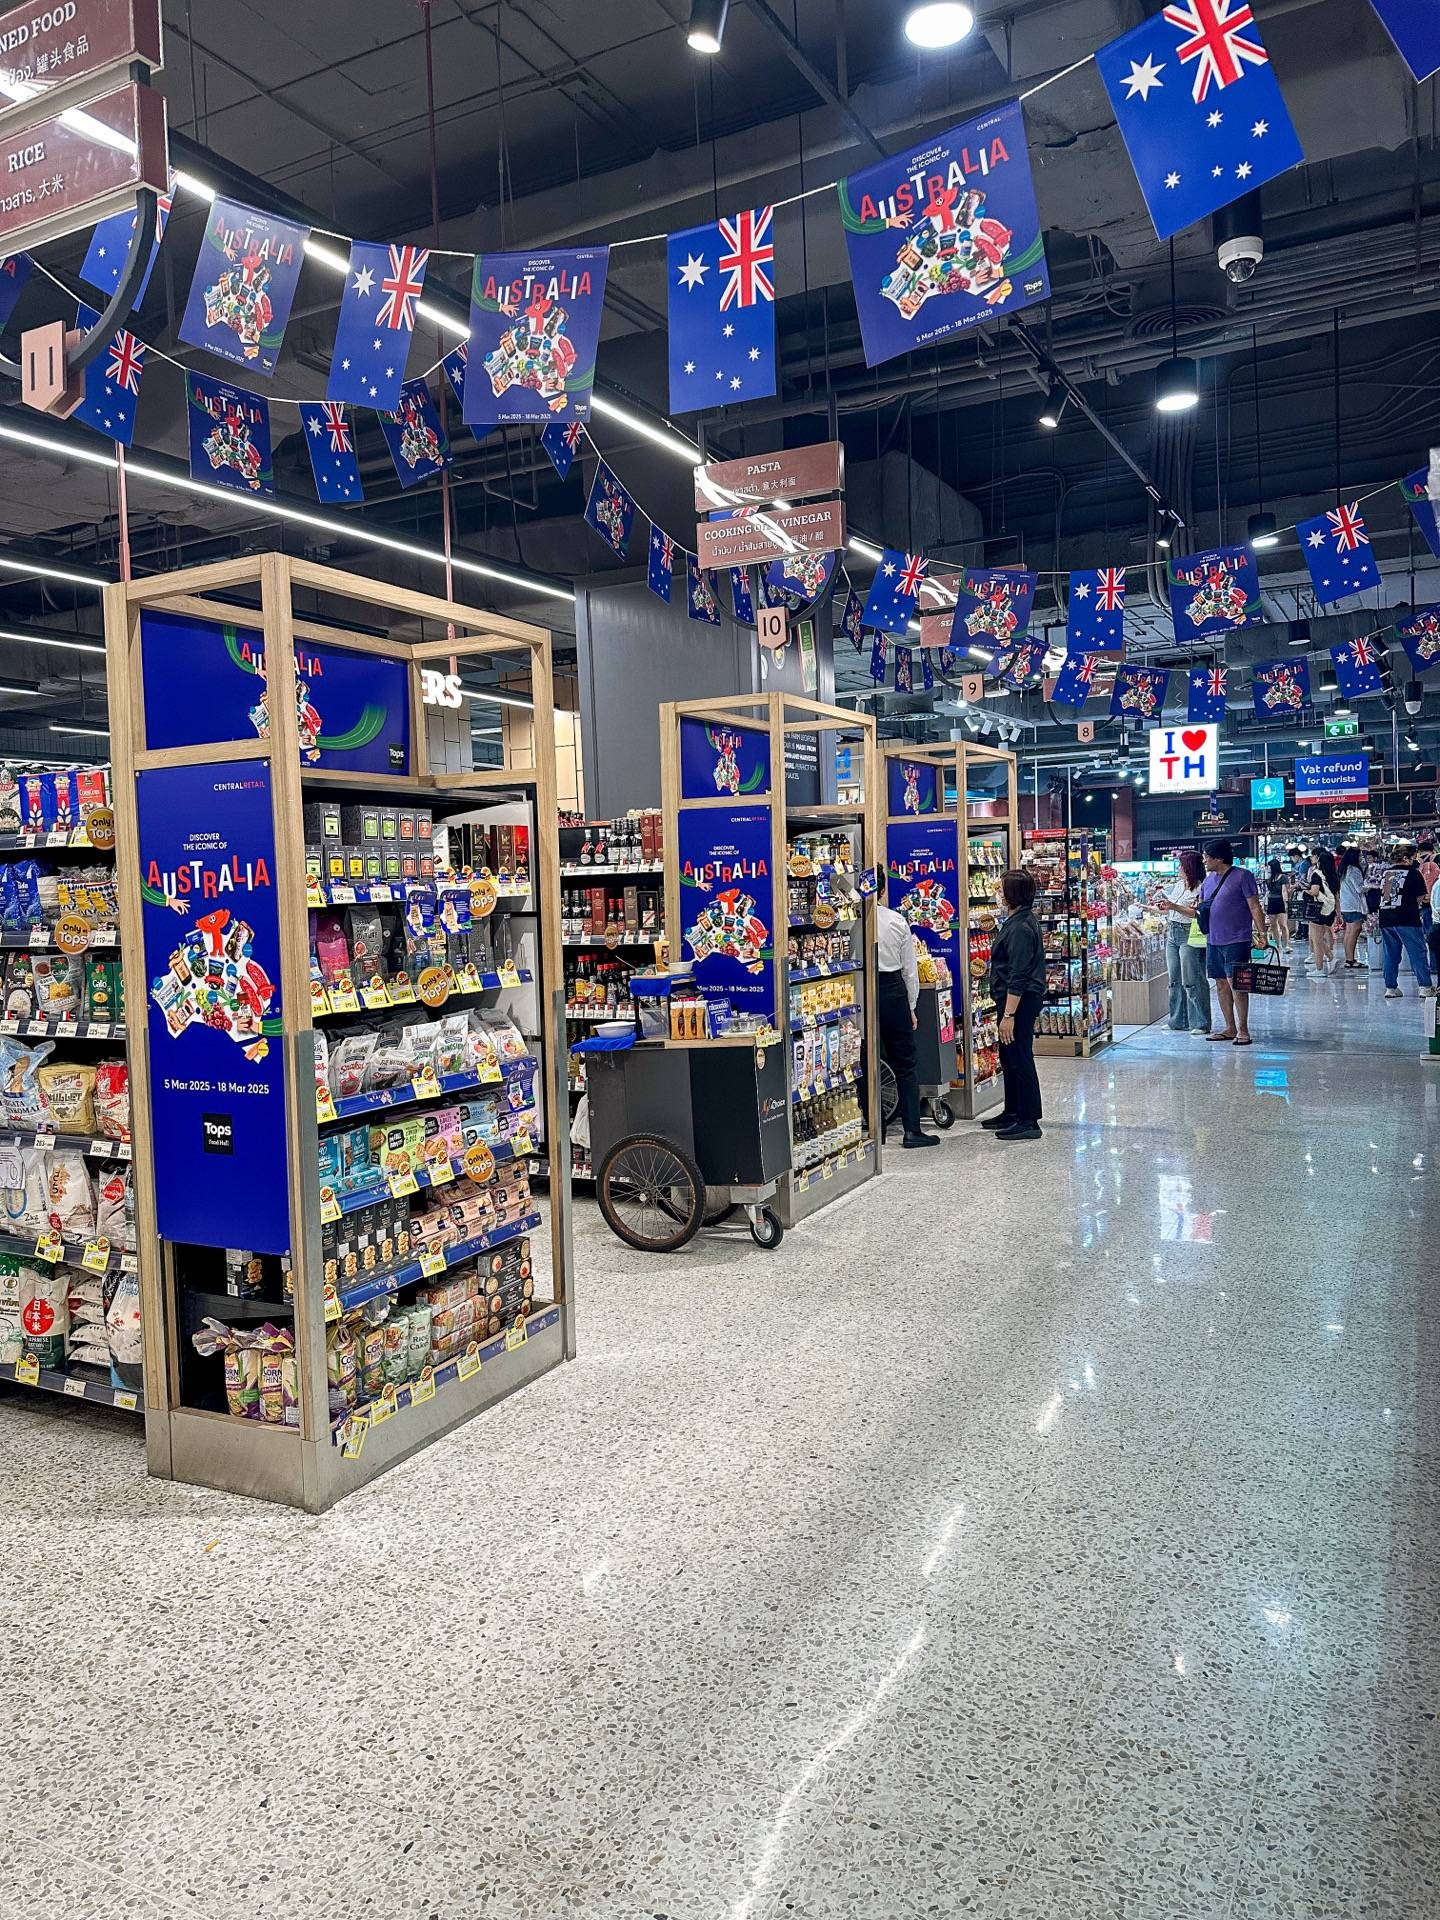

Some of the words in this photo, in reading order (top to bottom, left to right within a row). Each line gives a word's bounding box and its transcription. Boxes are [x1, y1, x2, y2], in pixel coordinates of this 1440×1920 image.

[31, 1, 76, 38] FOOD
[36, 34, 89, 75] 罐头食品
[976, 116, 1001, 132] CENTRAL
[8, 142, 45, 173] RICE
[906, 162, 918, 174] THE
[918, 153, 941, 169] ICONIC
[941, 150, 950, 159] OF
[911, 146, 942, 164] DISCOVER
[39, 173, 64, 200] 大米
[860, 137, 1010, 224] AUSTRALIA
[214, 216, 294, 266] AUSTRALIA
[483, 270, 592, 306] AUSTRALIA
[1024, 280, 1043, 292] Tops
[921, 330, 934, 341] Mar
[934, 324, 951, 336] 2025
[955, 319, 962, 327] 18
[963, 314, 976, 325] Mar
[976, 308, 993, 320] 2025
[30, 346, 54, 391] 11
[195, 387, 263, 425] AUSTRALIA
[747, 461, 782, 475] PASTA
[704, 524, 751, 541] COOKING
[782, 511, 832, 528] VINEGAR
[1176, 554, 1248, 582] AUSTRALIA
[966, 578, 1028, 597] AUSTRALIA
[762, 615, 781, 637] 10
[1122, 670, 1164, 685] AUSTRALIA
[1256, 664, 1303, 684] AUSTRALIA
[968, 682, 977, 695] 9
[1082, 727, 1090, 737] 8
[1164, 731, 1175, 754] I
[389, 748, 404, 759] Tops
[1301, 764, 1321, 775] Vat
[1323, 760, 1363, 773] refund
[1307, 777, 1320, 785] for
[1321, 775, 1357, 784] tourists
[92, 817, 111, 826] Only
[1332, 809, 1372, 819] CASHIER
[189, 833, 220, 841] DISCOVER
[183, 843, 195, 851] THE
[195, 842, 218, 850] ICONIC
[683, 857, 768, 883] AUSTRALIA
[890, 857, 955, 876] AUSTRALIA
[147, 855, 270, 899] AUSTRALIA
[333, 893, 345, 901] 145
[816, 915, 832, 923] Tops
[63, 923, 82, 933] Only
[59, 931, 88, 947] Tops
[421, 976, 436, 991] Only
[424, 979, 448, 1002] Tops
[164, 1079, 170, 1090] 5
[171, 1080, 188, 1091] Mar
[189, 1081, 210, 1092] 2025
[217, 1083, 227, 1092] 18
[229, 1083, 246, 1094] Mar
[247, 1083, 269, 1095] 2025
[203, 1121, 232, 1138] Tops
[468, 1154, 483, 1165] Only
[468, 1159, 493, 1176] Tops
